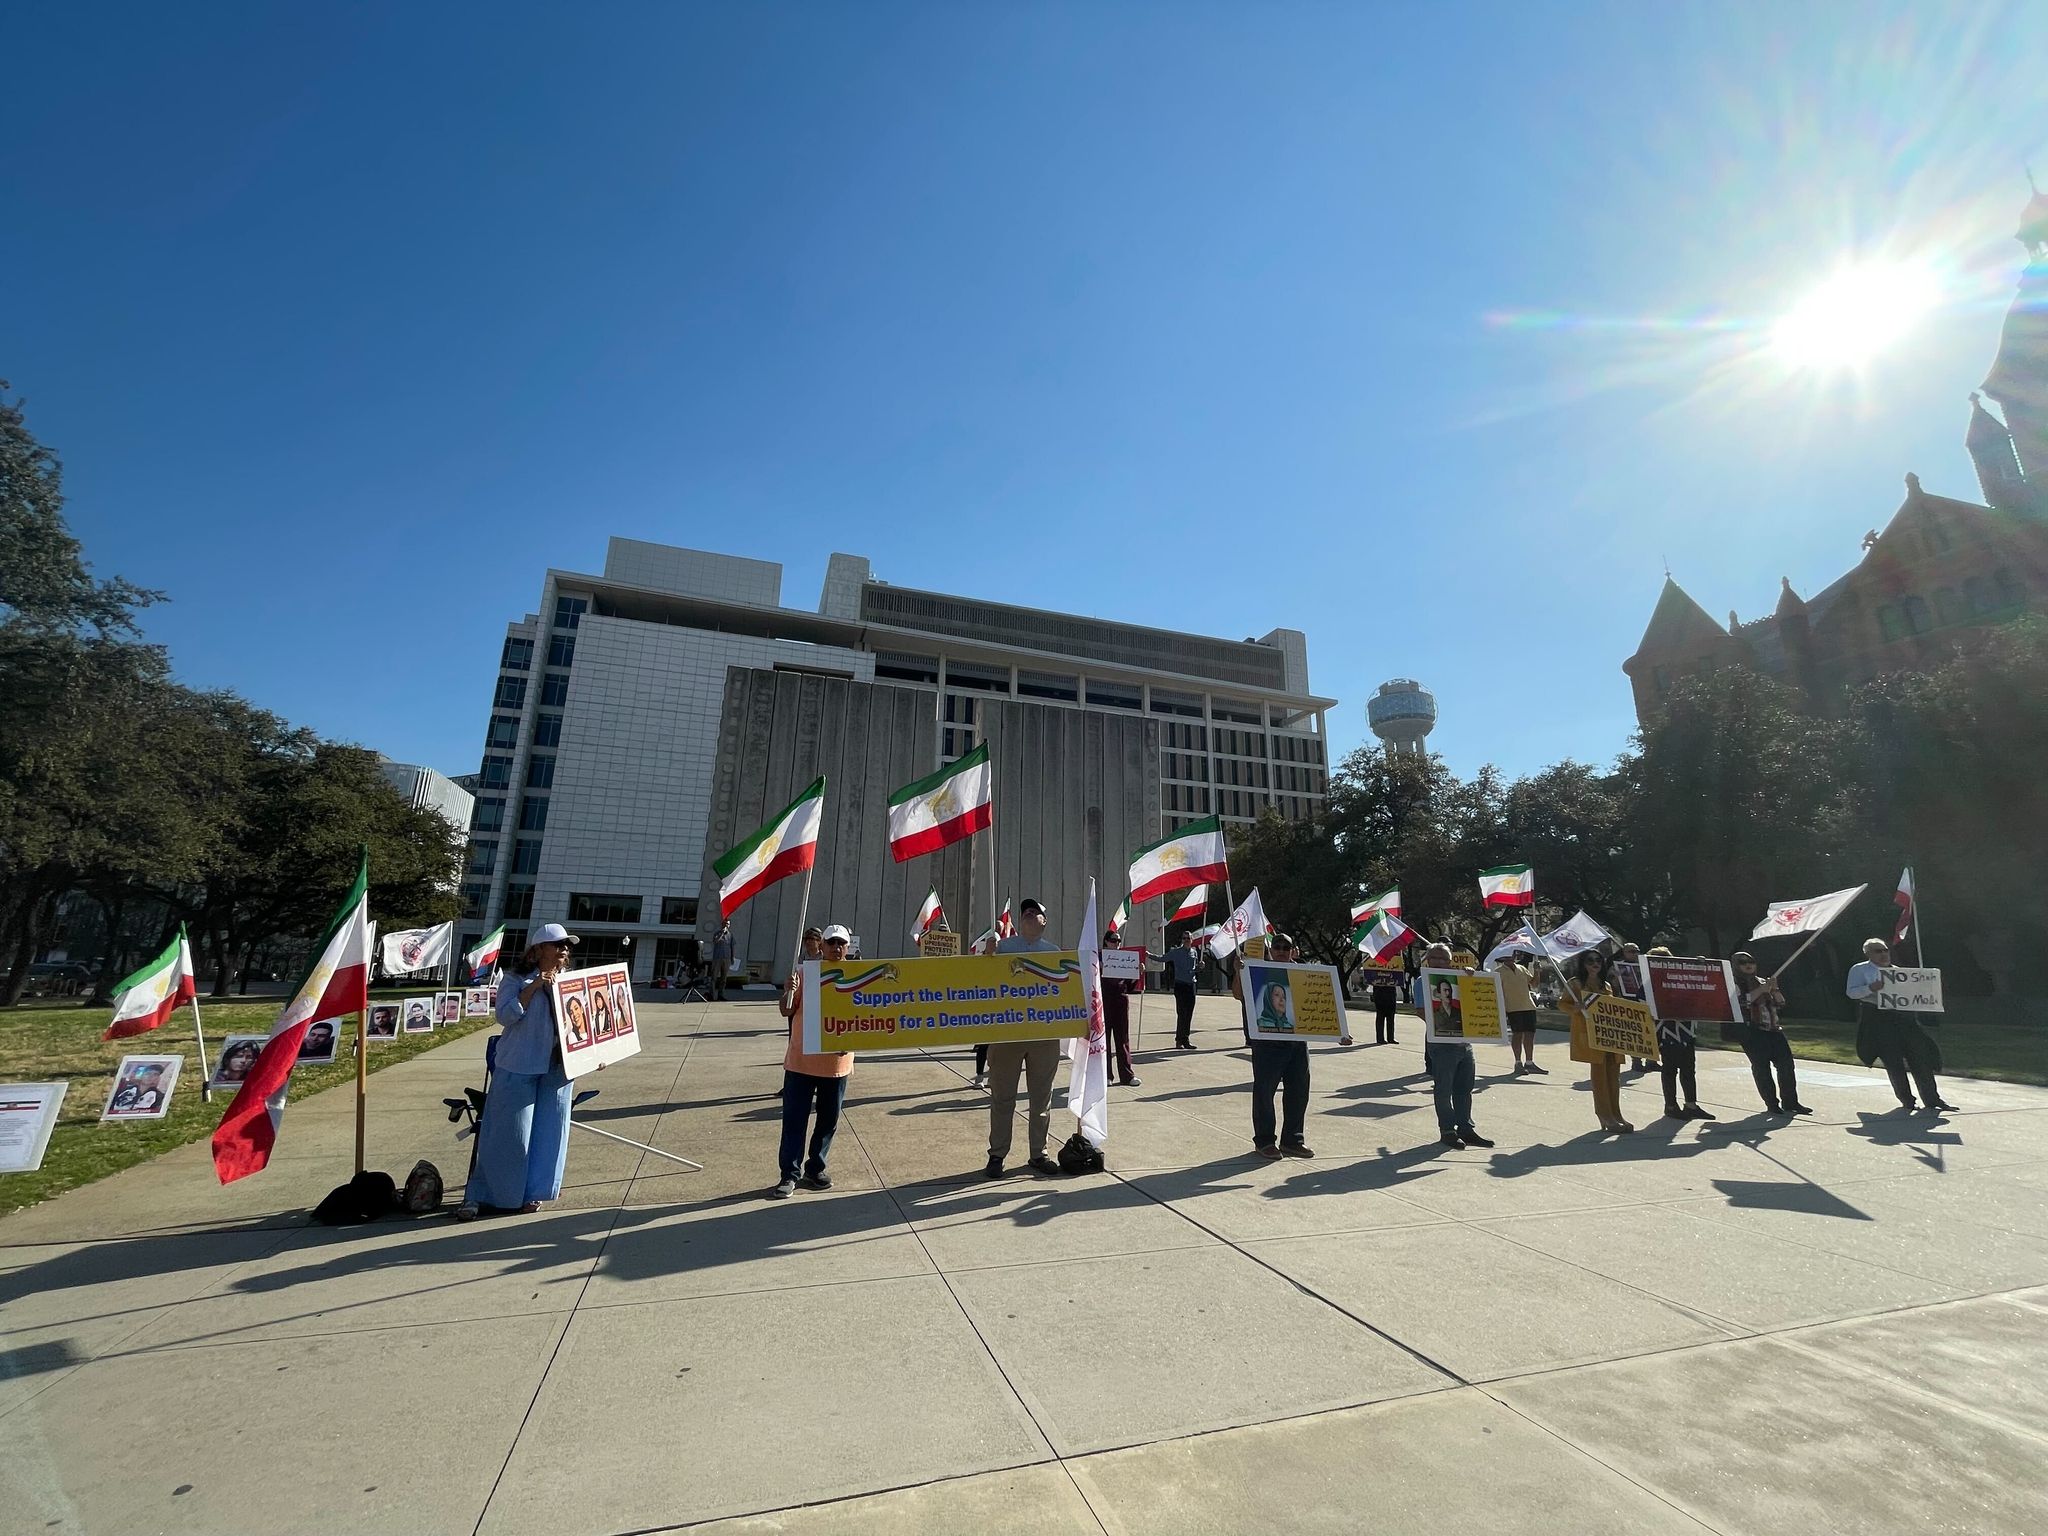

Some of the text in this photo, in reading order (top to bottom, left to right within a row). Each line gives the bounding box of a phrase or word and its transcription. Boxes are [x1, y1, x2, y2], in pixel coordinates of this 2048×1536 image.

[929, 934, 957, 943] SUPPORT
[852, 982, 1060, 1008] Support the Iranian People's
[824, 1004, 1088, 1036] Uprising for a Democratic Republic
[1598, 1001, 1646, 1022] SUPPORT
[1592, 1013, 1643, 1033] UPRISINGS
[1595, 1025, 1644, 1044] PROTESTS
[1596, 1037, 1654, 1056] PEOPLE IN IRAN
